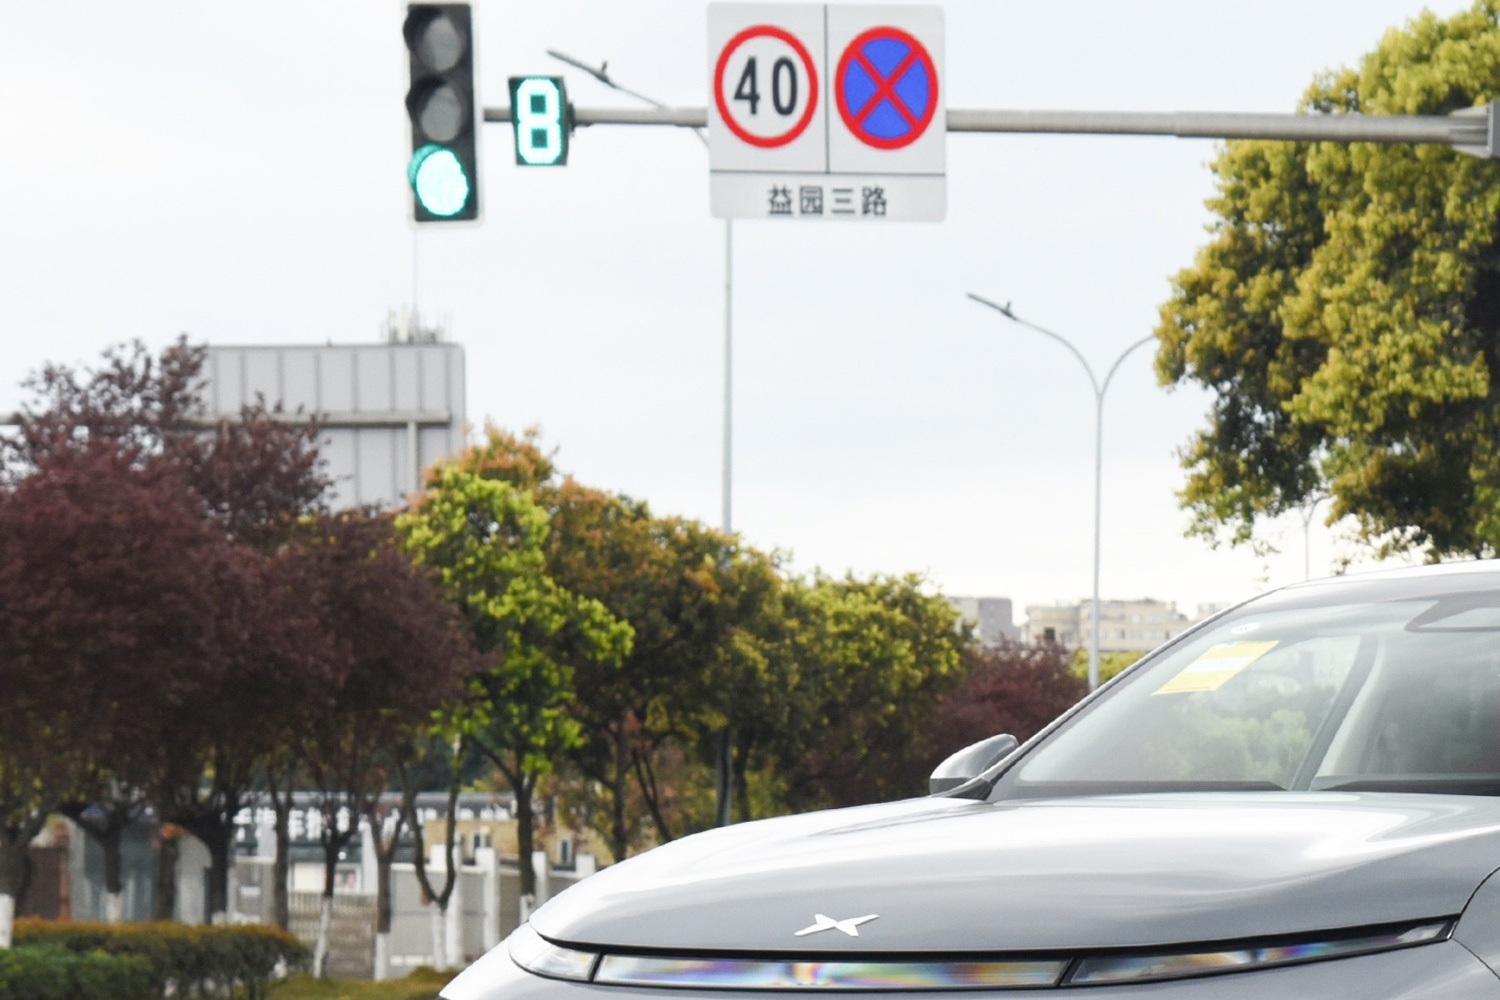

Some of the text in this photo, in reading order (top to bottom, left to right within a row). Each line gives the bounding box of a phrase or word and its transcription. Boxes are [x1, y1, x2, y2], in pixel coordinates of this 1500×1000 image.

[733, 56, 798, 117] 40
[516, 77, 562, 165] 8
[768, 185, 887, 216] 益园三路
